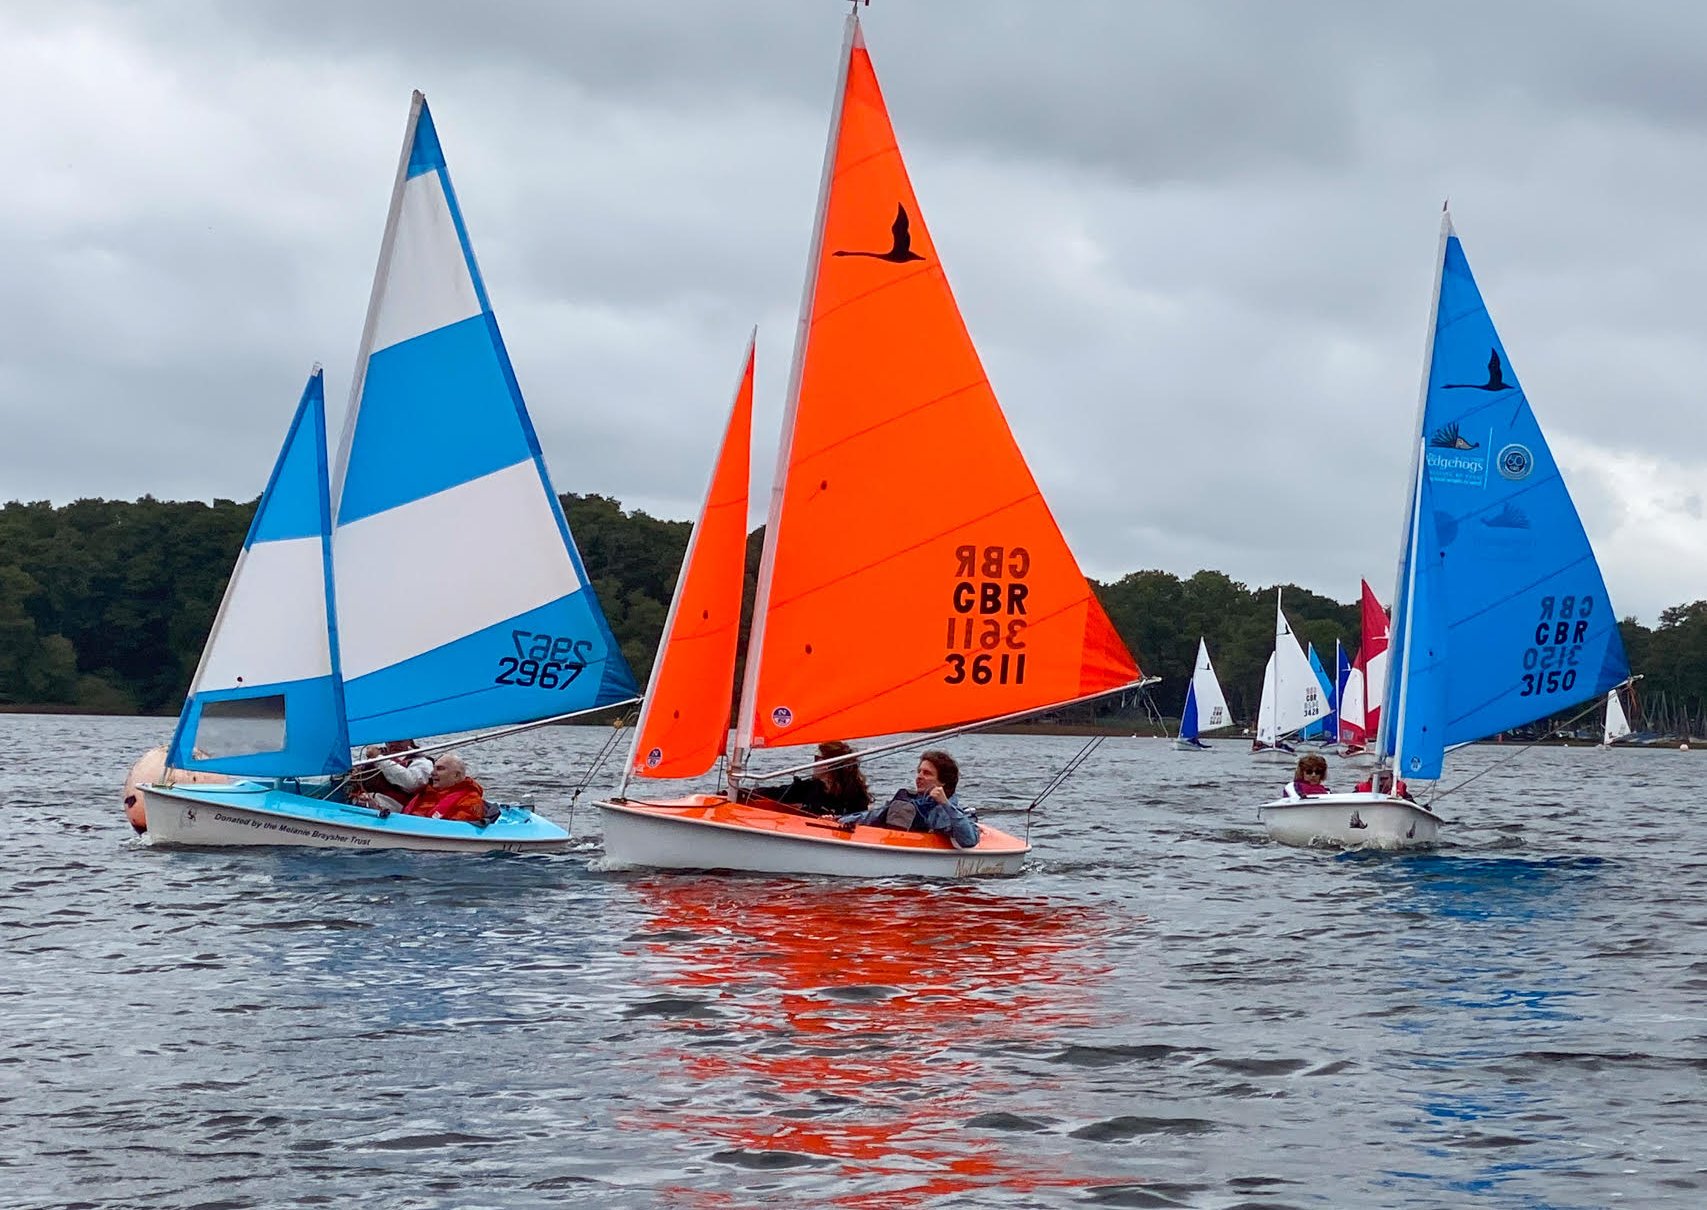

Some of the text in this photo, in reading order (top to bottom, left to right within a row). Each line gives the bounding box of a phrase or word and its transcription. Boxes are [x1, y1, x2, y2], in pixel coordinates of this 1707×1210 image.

[953, 581, 1029, 615] GBR
[1535, 620, 1588, 646] GBR
[494, 656, 584, 690] 2967
[943, 653, 1026, 685] 3611
[1520, 669, 1576, 697] 3150
[214, 813, 251, 826] Donated
[251, 820, 263, 828] by
[263, 822, 278, 830] the
[278, 824, 311, 836] Melanie
[351, 835, 371, 846] Trust
